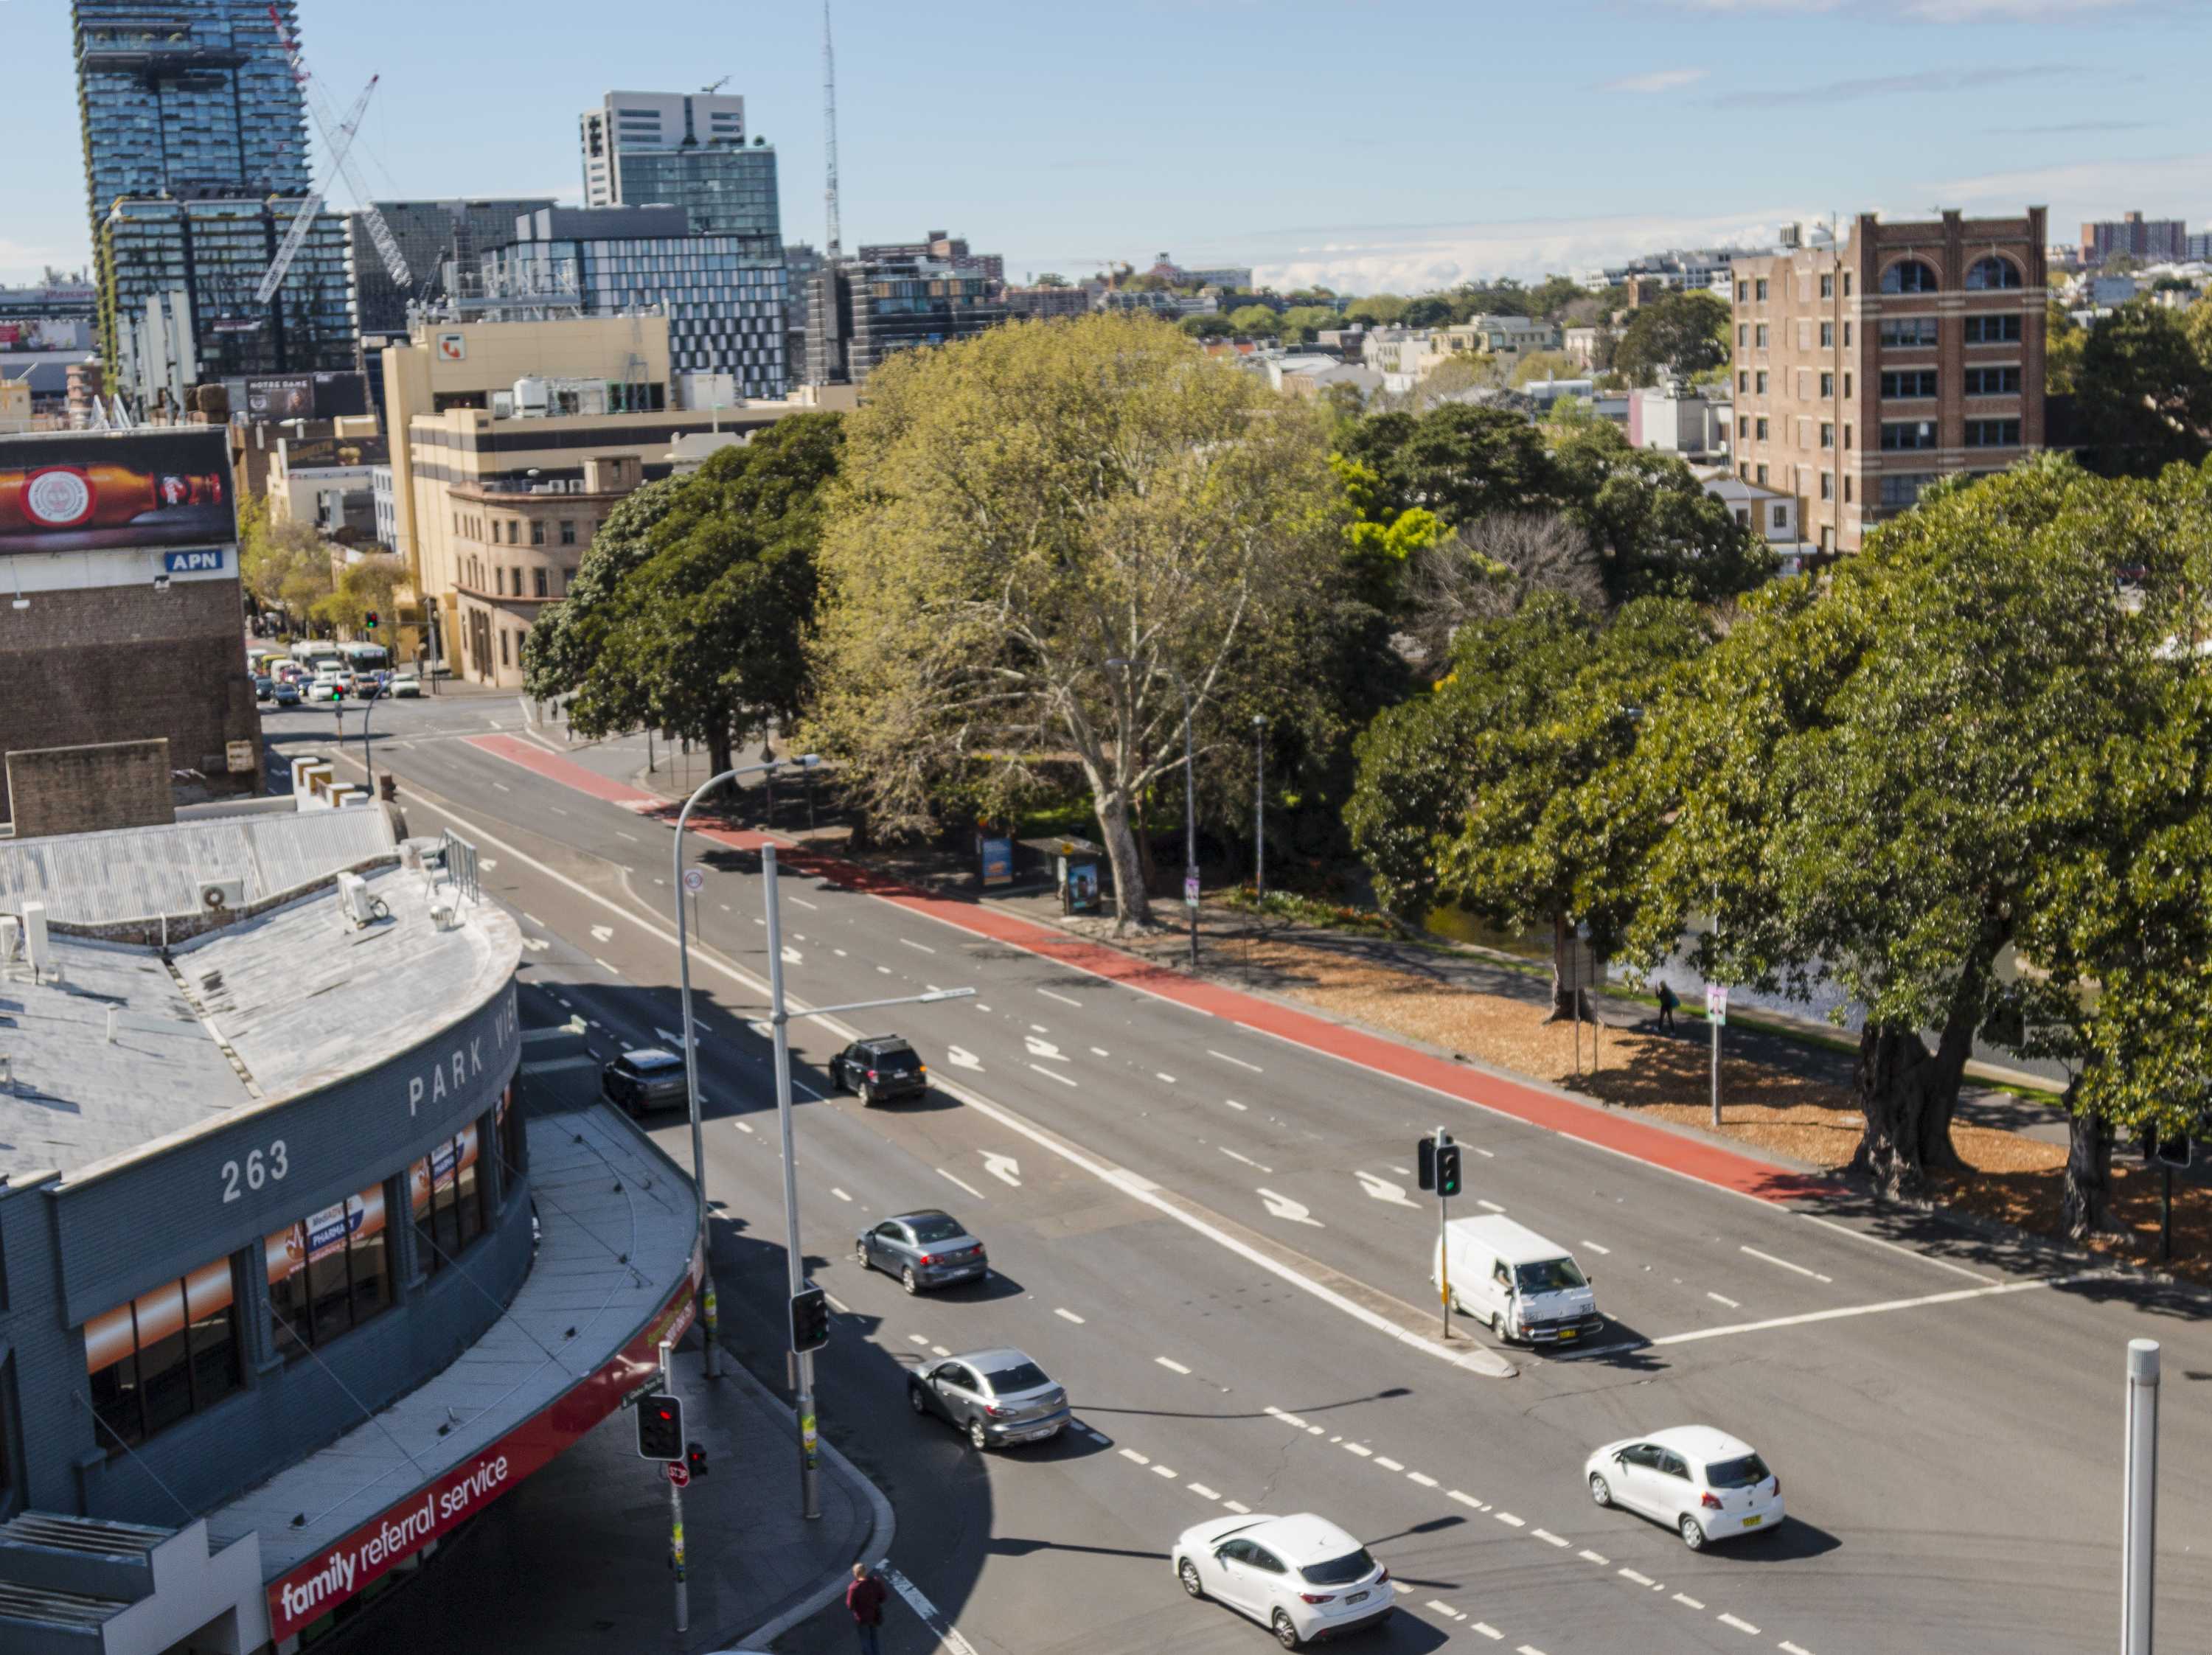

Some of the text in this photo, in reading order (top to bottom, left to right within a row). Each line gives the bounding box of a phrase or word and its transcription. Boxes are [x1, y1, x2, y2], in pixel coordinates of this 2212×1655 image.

[173, 552, 217, 570] APN
[409, 983, 518, 1117] PARK VIE
[221, 1140, 288, 1203] 263
[312, 1218, 355, 1247] PHARMAY
[669, 1466, 687, 1479] STOP
[281, 1456, 508, 1621] family referral service
